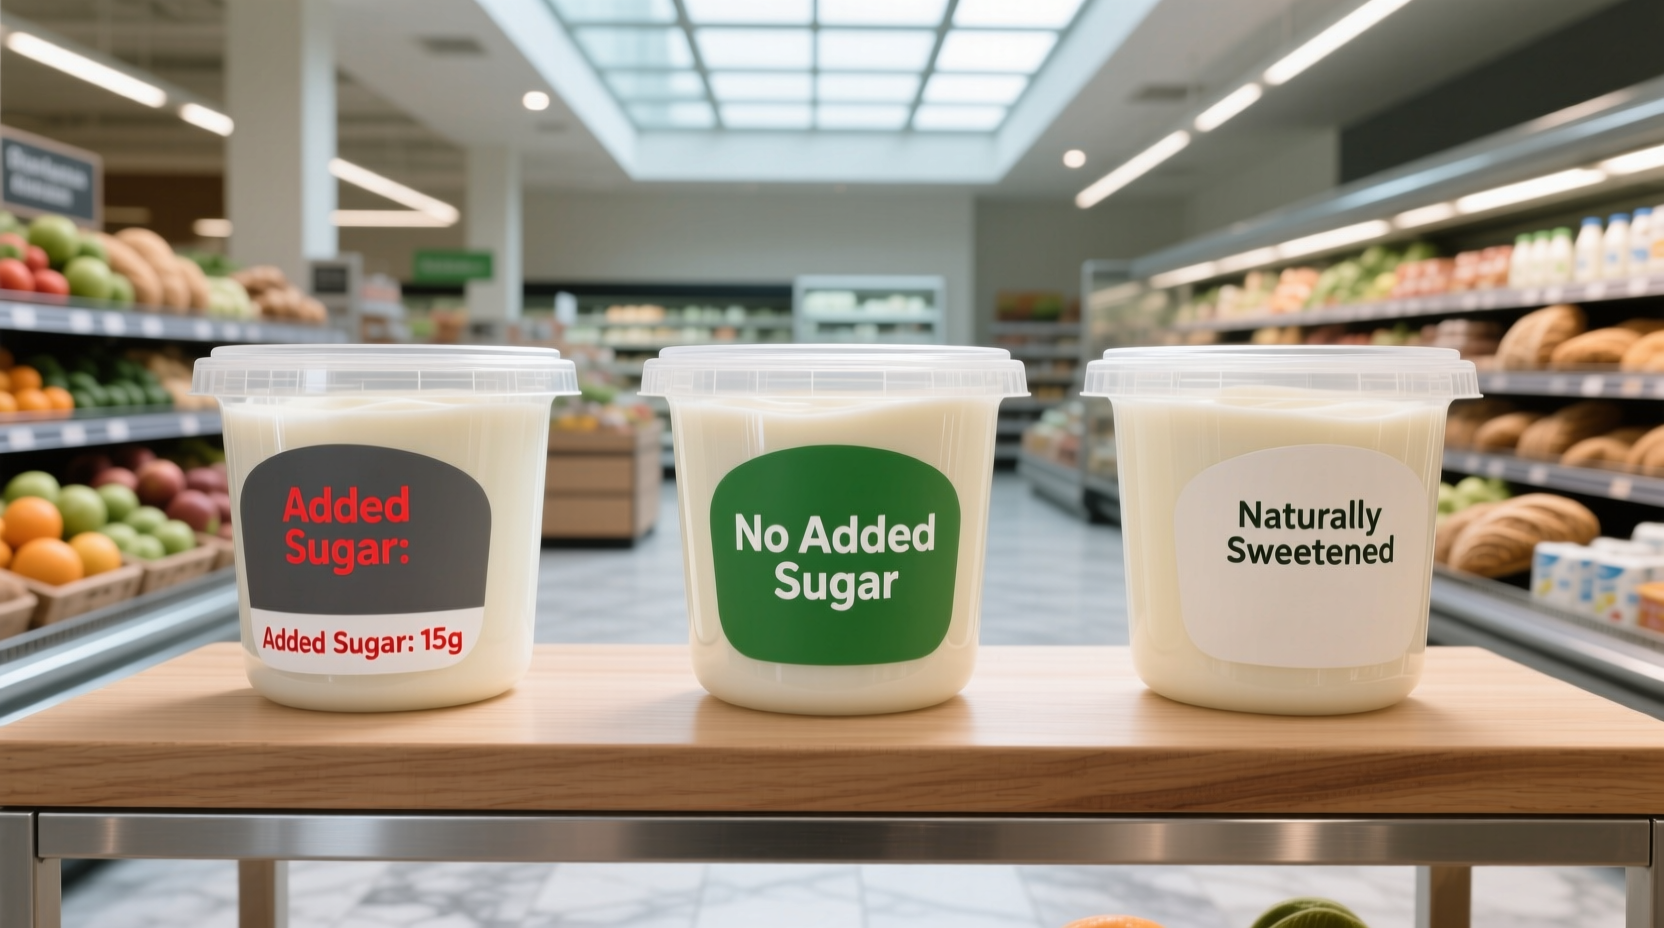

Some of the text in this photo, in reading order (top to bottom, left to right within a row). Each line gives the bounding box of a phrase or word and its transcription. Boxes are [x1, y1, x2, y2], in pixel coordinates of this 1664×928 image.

[283, 485, 409, 524] Added
[1239, 499, 1382, 537] Naturally
[285, 528, 409, 575] Sugar:
[736, 513, 935, 553] No Added
[1227, 534, 1394, 565] Sweetened
[775, 562, 898, 611] Sugar
[263, 627, 462, 660] Added Sugar: 15g
